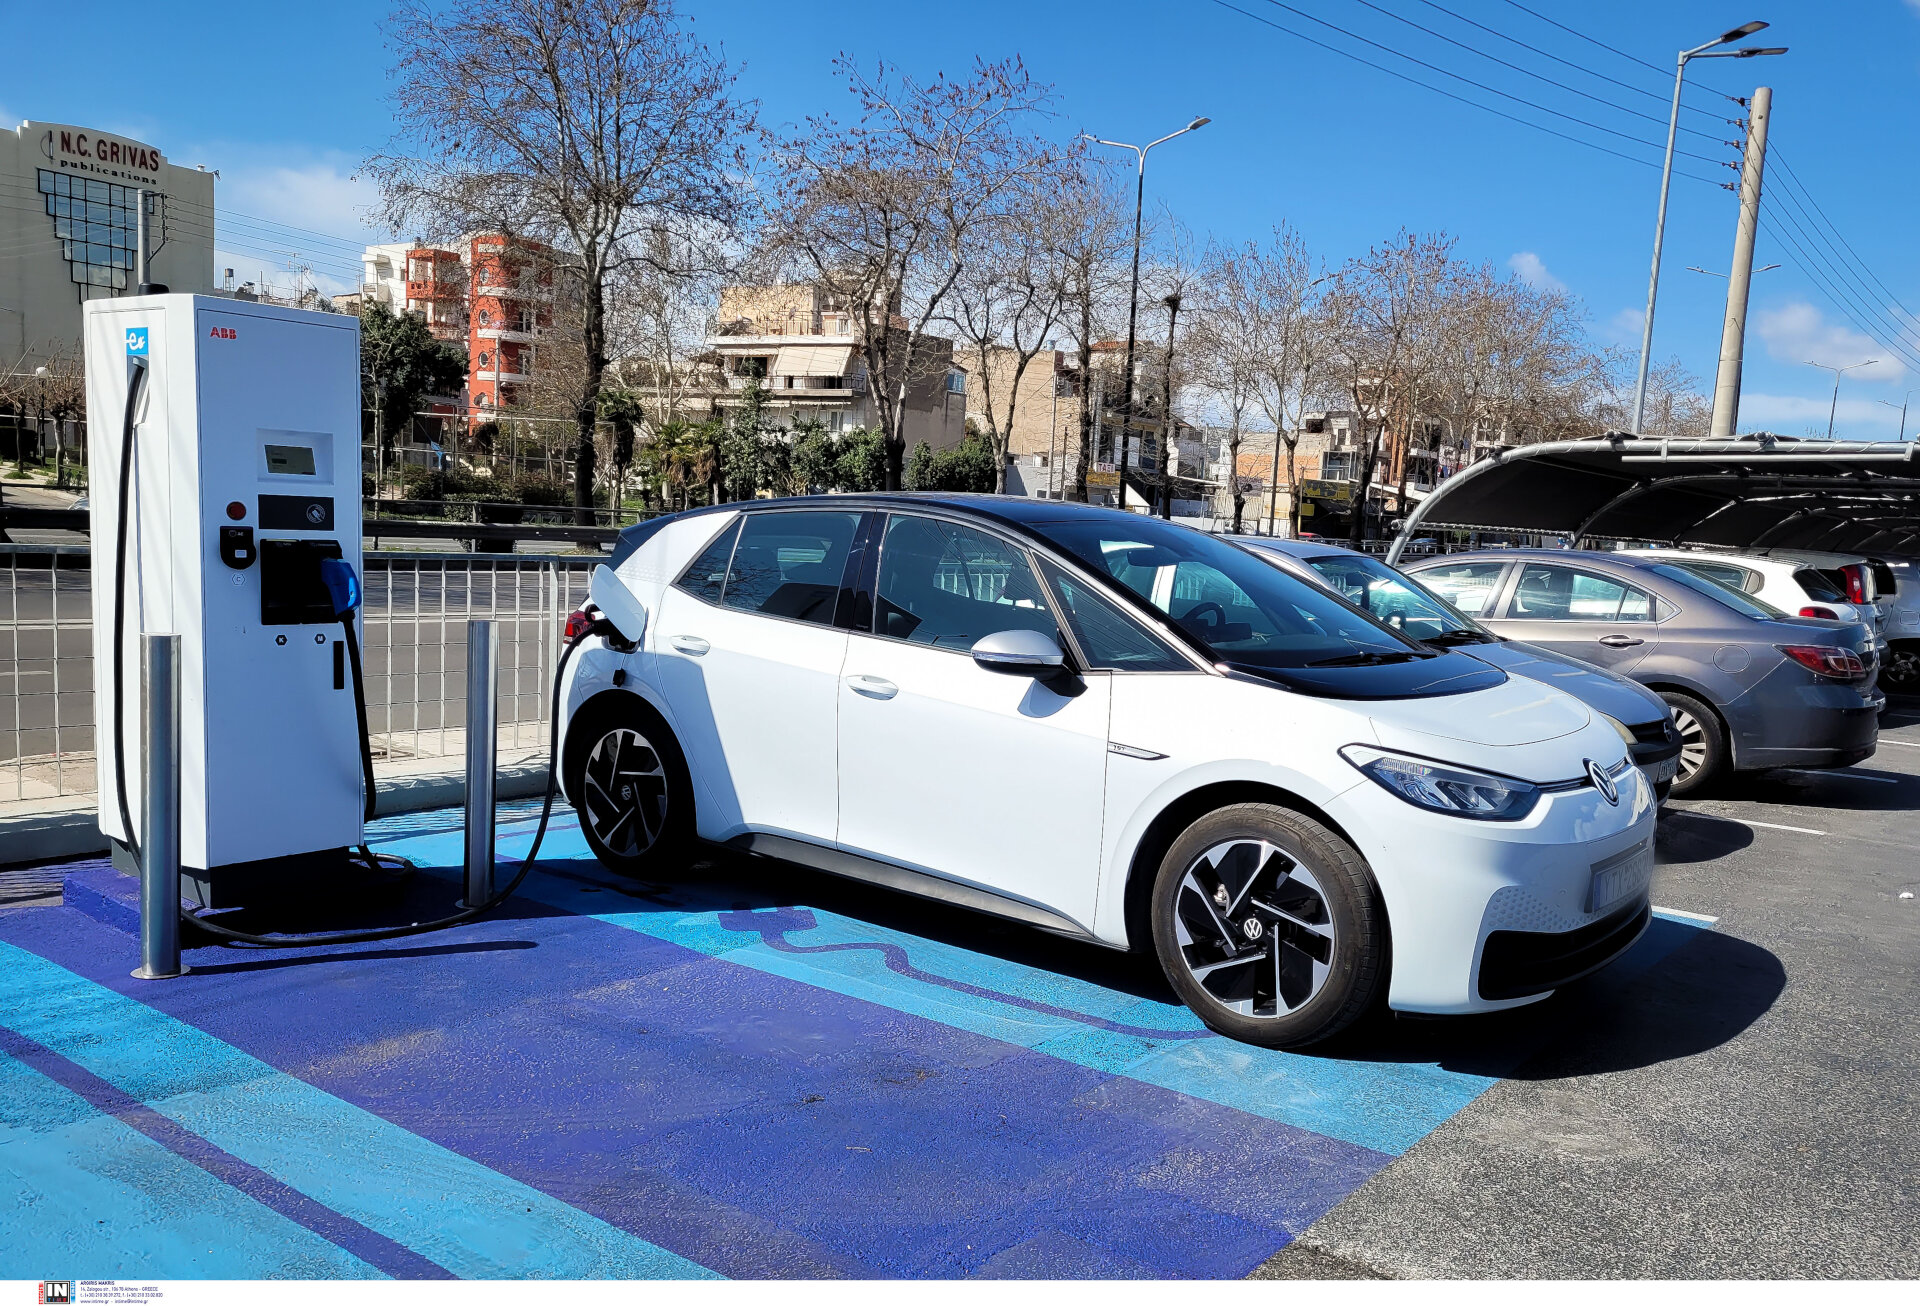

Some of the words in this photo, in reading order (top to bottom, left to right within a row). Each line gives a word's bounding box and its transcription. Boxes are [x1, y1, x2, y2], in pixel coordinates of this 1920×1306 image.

[61, 131, 92, 158] N.C.
[97, 138, 159, 172] GRIVAS
[60, 159, 158, 185] publications
[210, 326, 237, 340] ABB
